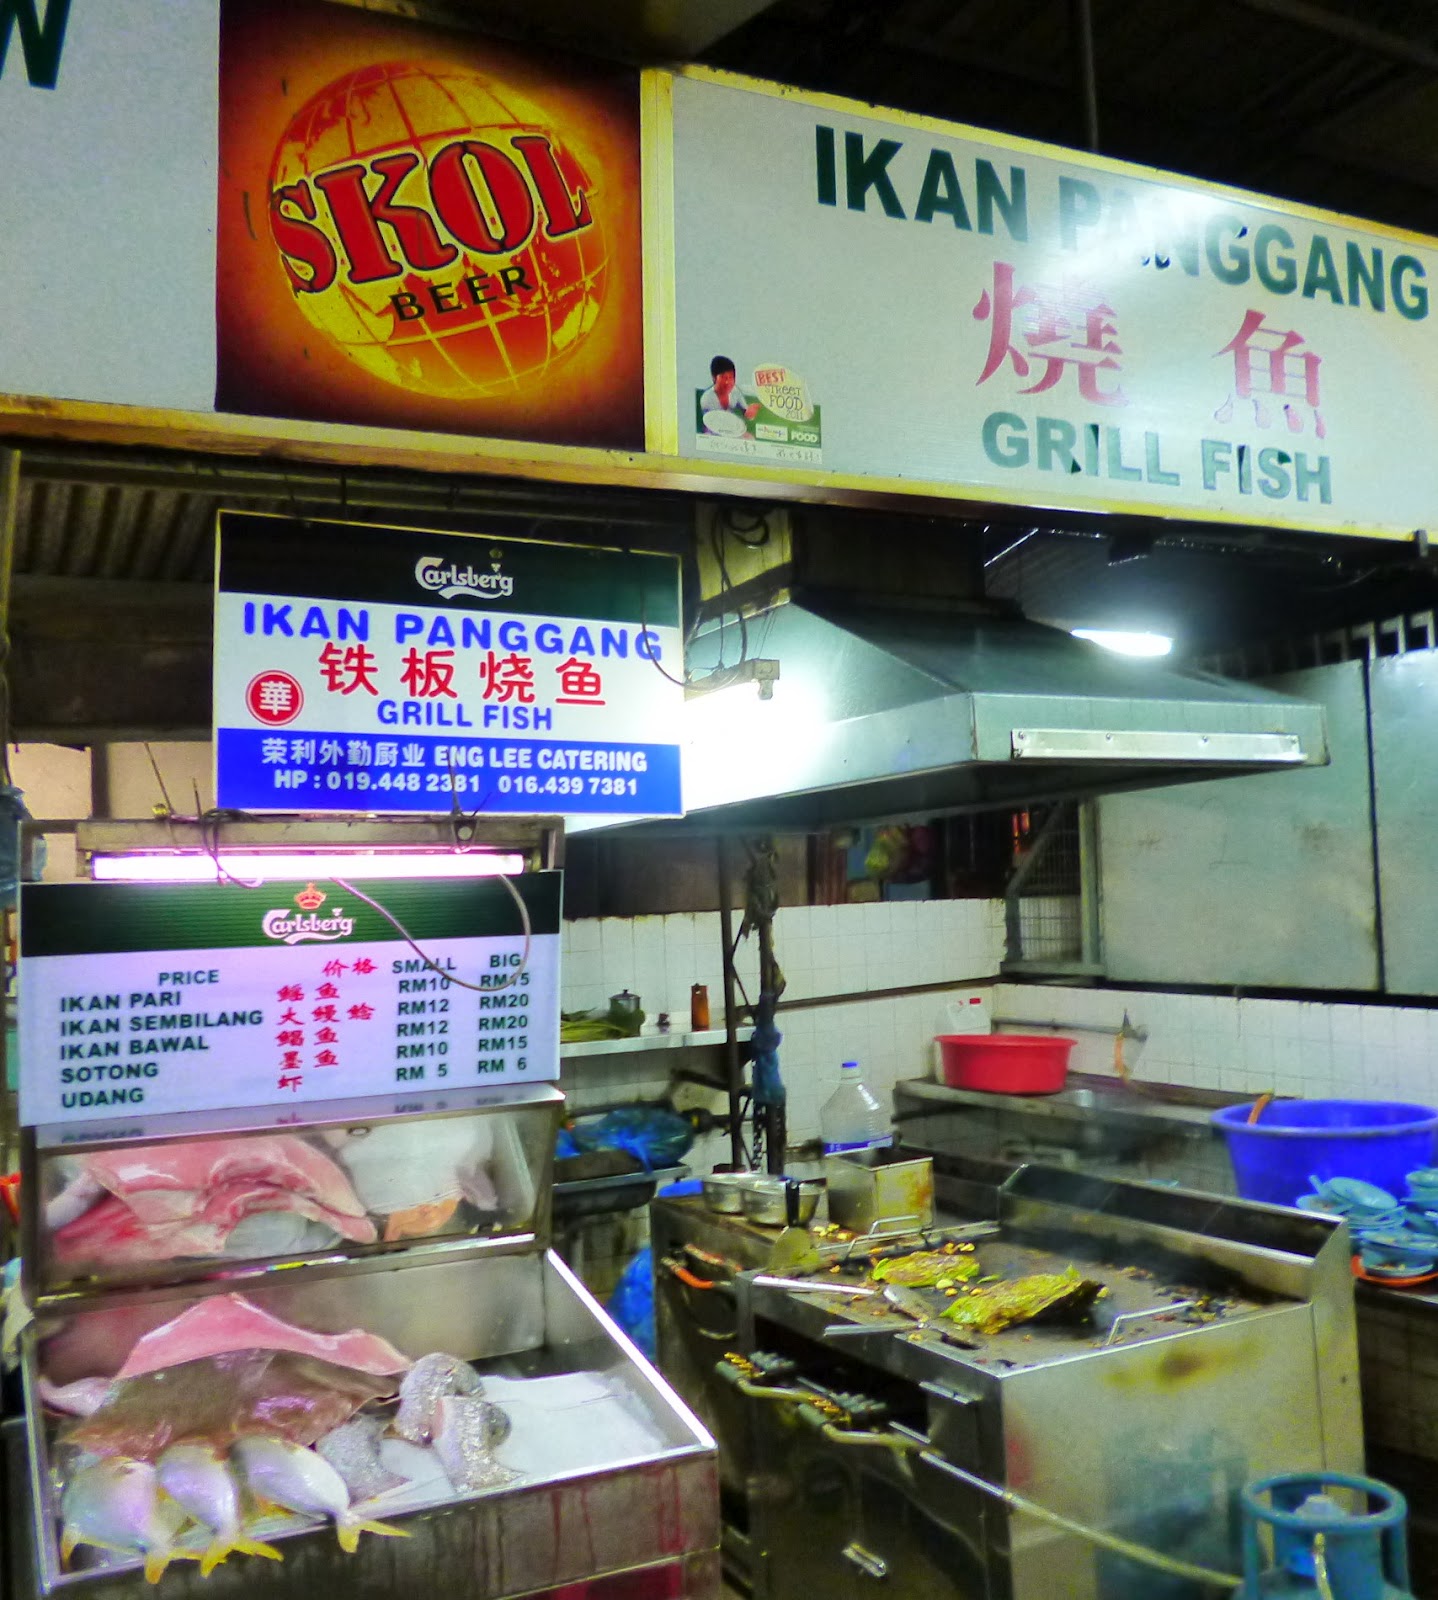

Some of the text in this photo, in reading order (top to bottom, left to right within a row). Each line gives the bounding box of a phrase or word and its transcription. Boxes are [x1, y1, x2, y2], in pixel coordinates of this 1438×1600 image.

[815, 125, 1028, 242] IKAN
[270, 135, 593, 294] SKOL
[390, 265, 533, 322] BEER
[757, 370, 785, 384] BEST
[769, 395, 803, 410] FOOD
[791, 431, 818, 443] FOOD
[981, 411, 1332, 503] GRILL FISH
[415, 556, 514, 599] Carlsberg
[244, 602, 663, 661] IKAN PANGGANG
[318, 642, 606, 705] 铁板烧鱼
[259, 680, 292, 716] 華
[377, 700, 553, 731] GRILL FISH
[262, 737, 648, 772] 荣利外勤厨业 ENG LEE CATERING
[326, 771, 421, 791] 019.448
[426, 773, 480, 793] 2381
[498, 775, 583, 794] 016.439
[588, 777, 637, 795] 7381
[262, 908, 354, 945] Carlsberg
[322, 958, 378, 978] 价格
[392, 957, 457, 974] SMALL
[489, 953, 522, 968] BIG
[158, 969, 220, 986] PRICE
[398, 977, 450, 993] RM10
[60, 991, 181, 1012] IKAN PARI
[398, 999, 449, 1016] RM12
[479, 993, 529, 1010] RM20
[60, 1010, 263, 1036] IKAN SEMBILANG
[397, 1020, 448, 1037] RM12
[478, 1015, 528, 1031] RM20
[60, 1036, 209, 1060] IKAN BAWAL
[396, 1041, 448, 1059] RM10
[478, 1036, 527, 1052] RM15
[61, 1062, 159, 1084] SOTONG
[277, 1075, 303, 1092] 虾
[61, 1088, 144, 1108] UDANG
